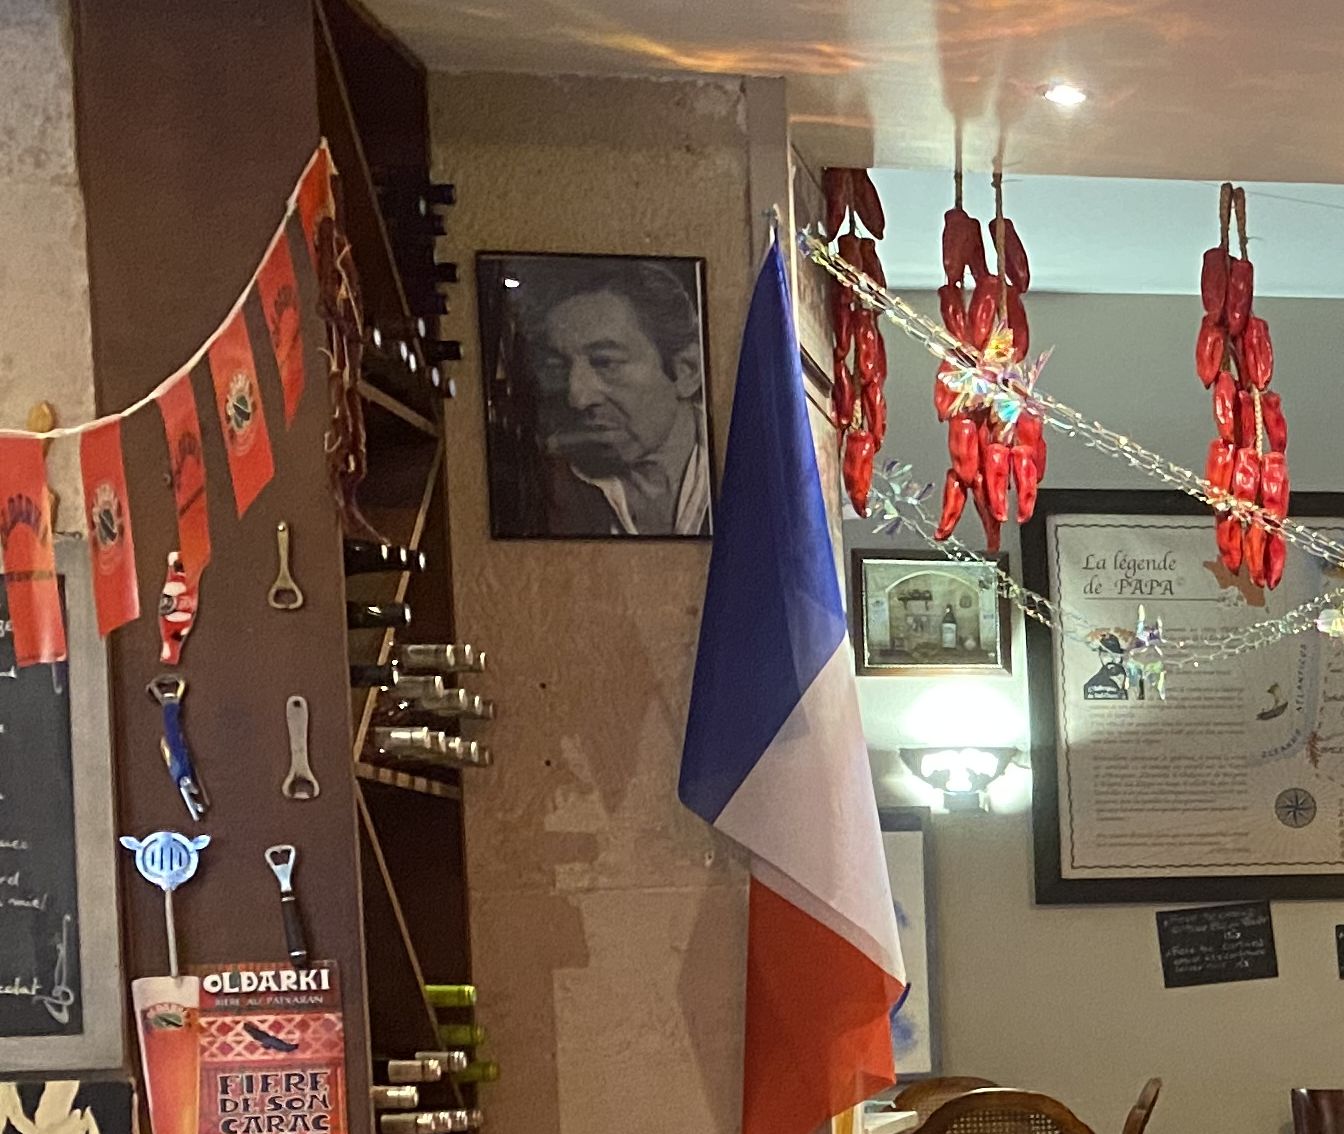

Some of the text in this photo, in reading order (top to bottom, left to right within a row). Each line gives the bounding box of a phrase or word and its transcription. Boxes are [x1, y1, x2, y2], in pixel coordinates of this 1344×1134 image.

[1082, 551, 1177, 578] La légende
[1083, 575, 1175, 596] de PAPA
[203, 969, 330, 994] OLDARKI
[218, 1071, 329, 1095] FIERE
[220, 1094, 330, 1114] DE SON
[220, 1114, 330, 1134] CARAC
